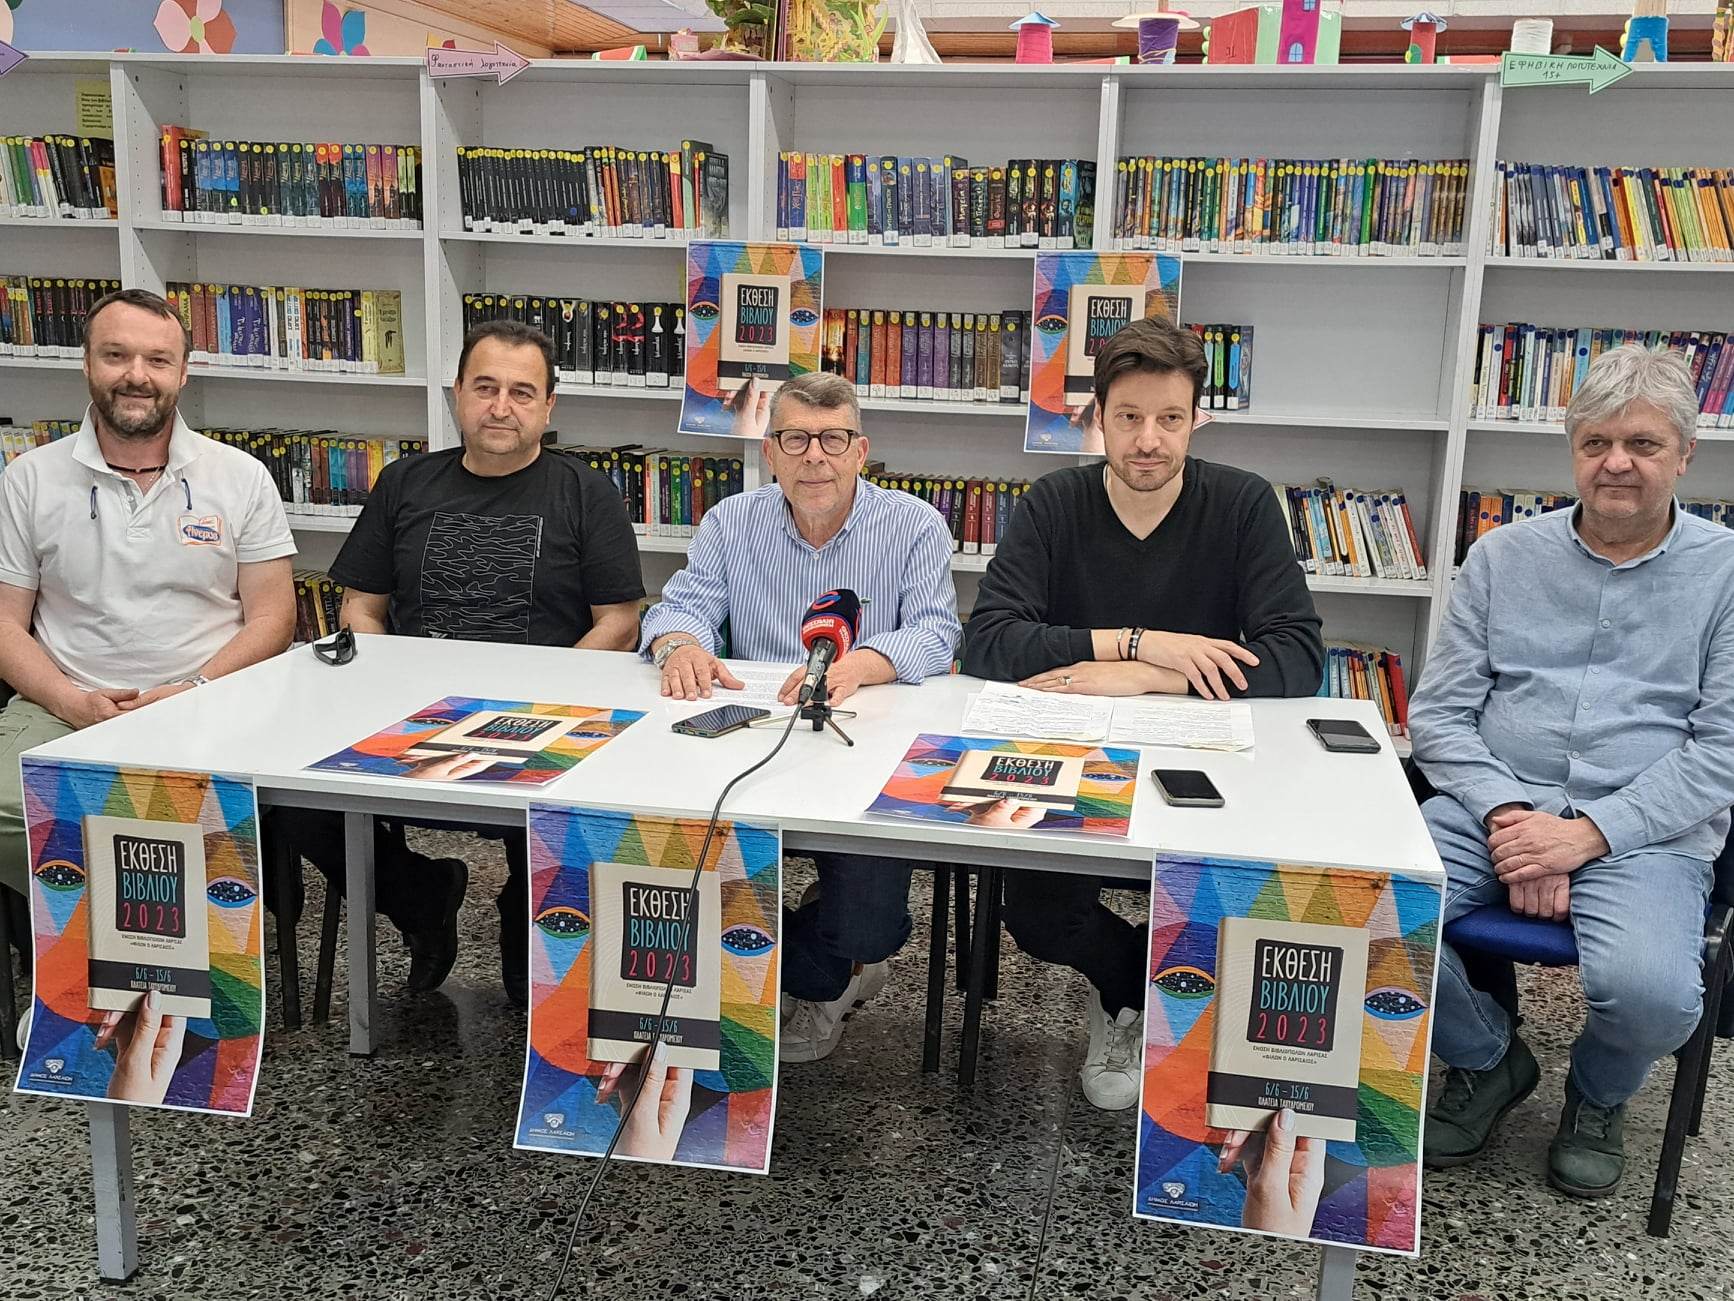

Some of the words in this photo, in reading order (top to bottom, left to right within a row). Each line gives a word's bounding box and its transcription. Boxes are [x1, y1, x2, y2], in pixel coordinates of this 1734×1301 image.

[1509, 60, 1564, 70] ΕΦΗΒΙΚΗ
[741, 288, 774, 307] ΕΚΘΕΣΗ
[740, 306, 774, 326] ΒΙΒΛΙΟΥ
[1091, 299, 1127, 318] ΕΚΘΕΣΗ
[740, 326, 773, 342] 2023
[484, 724, 543, 735] ΒΙΒΛΙΟΥ
[494, 717, 552, 728] ΕΚΘΕΣΗ
[993, 766, 1052, 776] ΒΙΒΛΙΟΥ
[996, 757, 1055, 769] ΕΚΘΕΣΗ
[990, 772, 1050, 785] 2023
[120, 840, 178, 874] ΕΚΘΕΣΗ
[122, 872, 178, 904] ΒΙΒΛΙΟΥ
[630, 888, 690, 921] ΕΚΘΕΣΗ
[122, 902, 182, 932] 2023
[135, 966, 148, 980] 6/6
[156, 969, 172, 982] 15/6
[628, 950, 690, 981] 2023
[1261, 946, 1332, 983] ΕΚΘΕΣΗ
[1260, 979, 1330, 1015] ΒΙΒΛΙΟΥ
[639, 1017, 652, 1030] 6/6
[662, 1019, 678, 1033] 15/6
[1256, 1012, 1328, 1045] 2023
[1265, 1082, 1280, 1096] 6/6
[1290, 1085, 1310, 1100] 15/6
